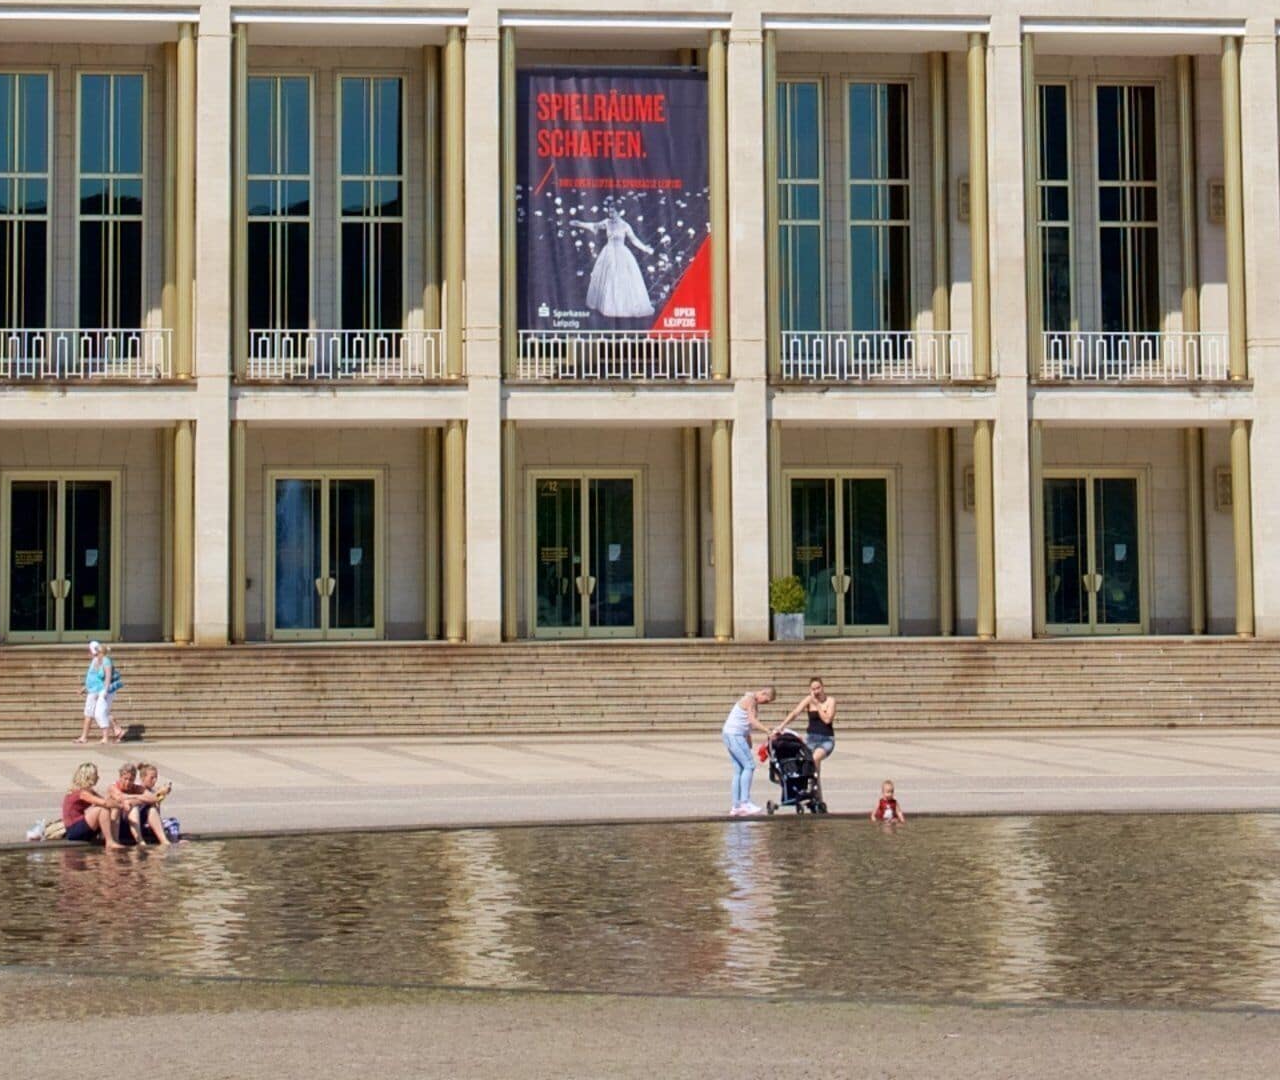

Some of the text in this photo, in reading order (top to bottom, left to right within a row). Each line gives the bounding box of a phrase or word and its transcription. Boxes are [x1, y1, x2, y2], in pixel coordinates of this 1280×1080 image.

[536, 89, 666, 123] SPIELRÄUME
[536, 128, 647, 159] SCHAFFEN.
[553, 309, 591, 318] Sparkasse
[673, 307, 696, 317] OPER
[553, 319, 580, 329] Leipzig
[663, 317, 696, 327] LEIPZIG
